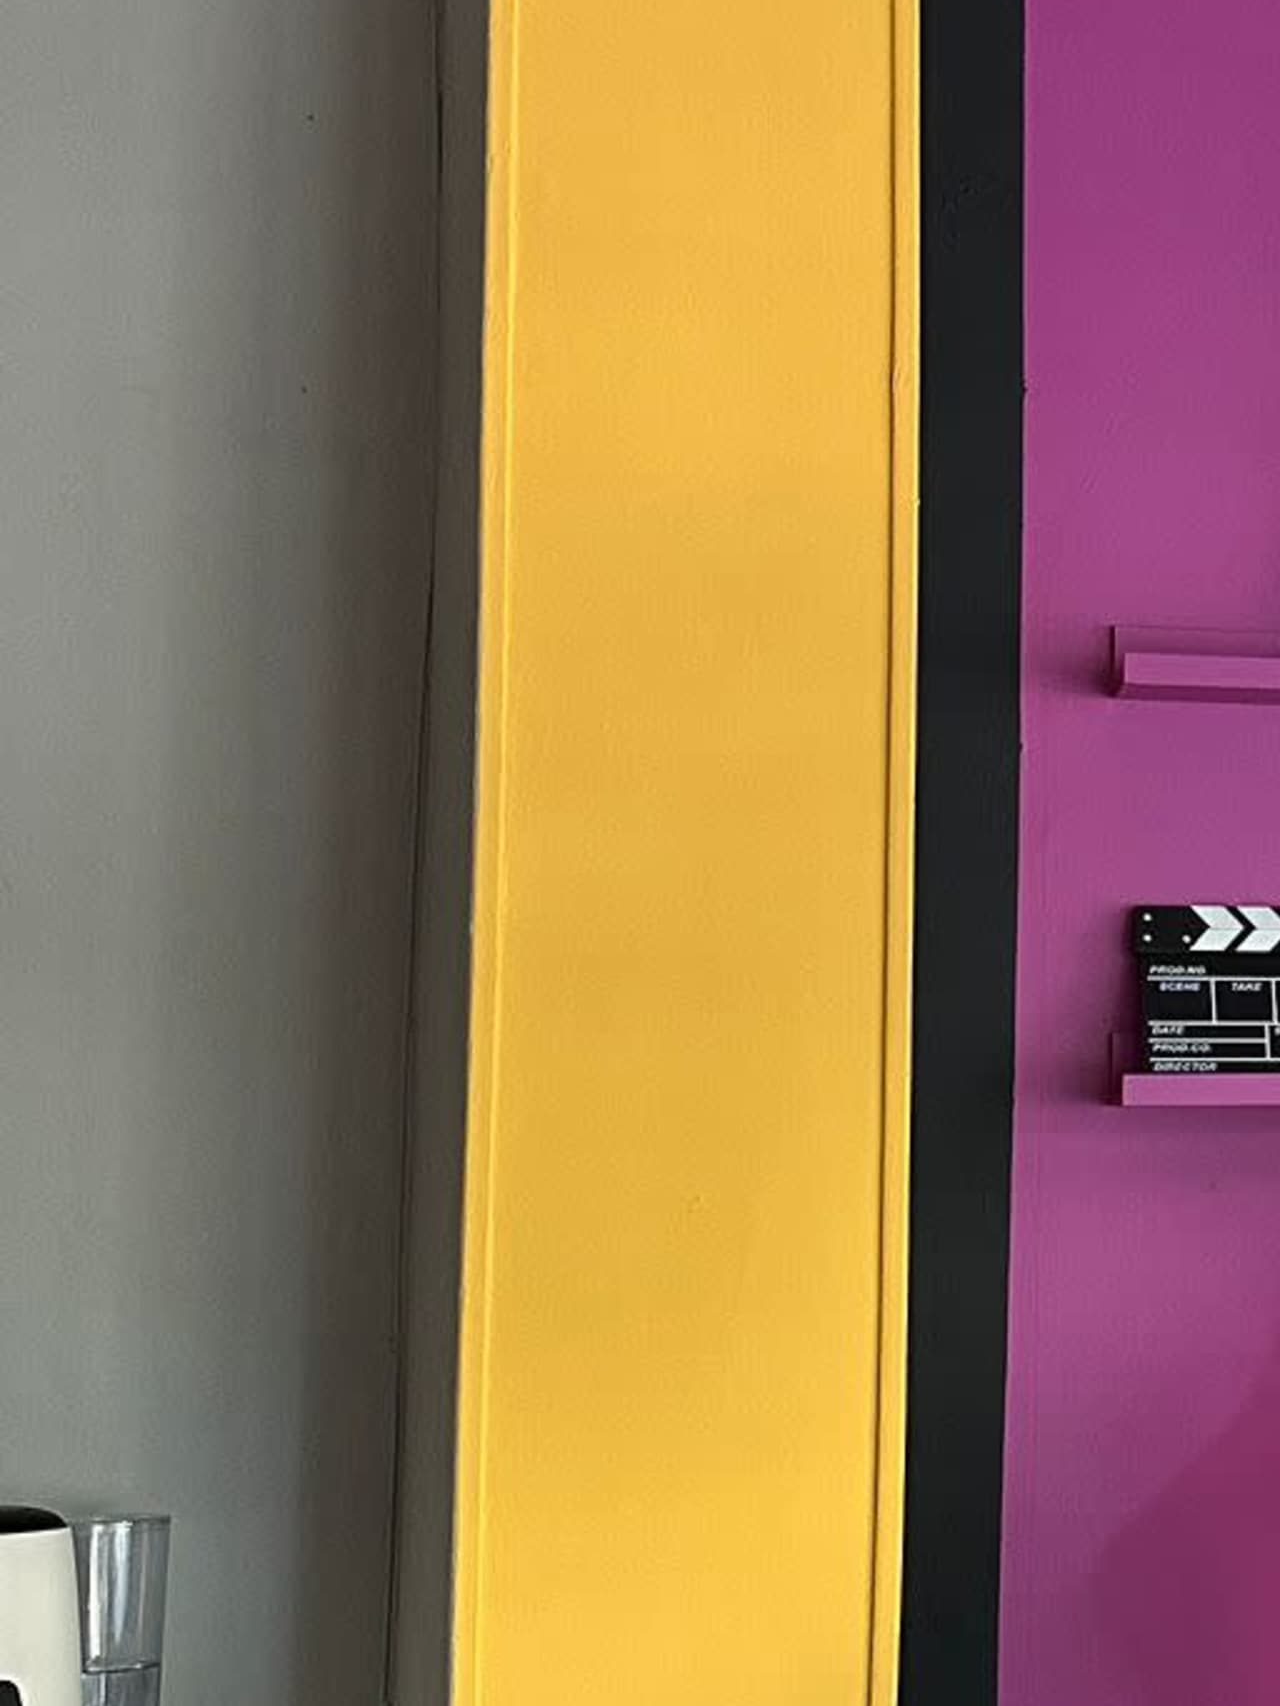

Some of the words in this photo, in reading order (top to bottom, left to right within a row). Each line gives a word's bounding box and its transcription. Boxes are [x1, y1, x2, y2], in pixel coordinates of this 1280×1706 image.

[1159, 982, 1201, 992] SCENE
[1231, 982, 1262, 992] TAKE
[1151, 1025, 1185, 1035] DATE
[1153, 1061, 1218, 1072] DIRECTOR
